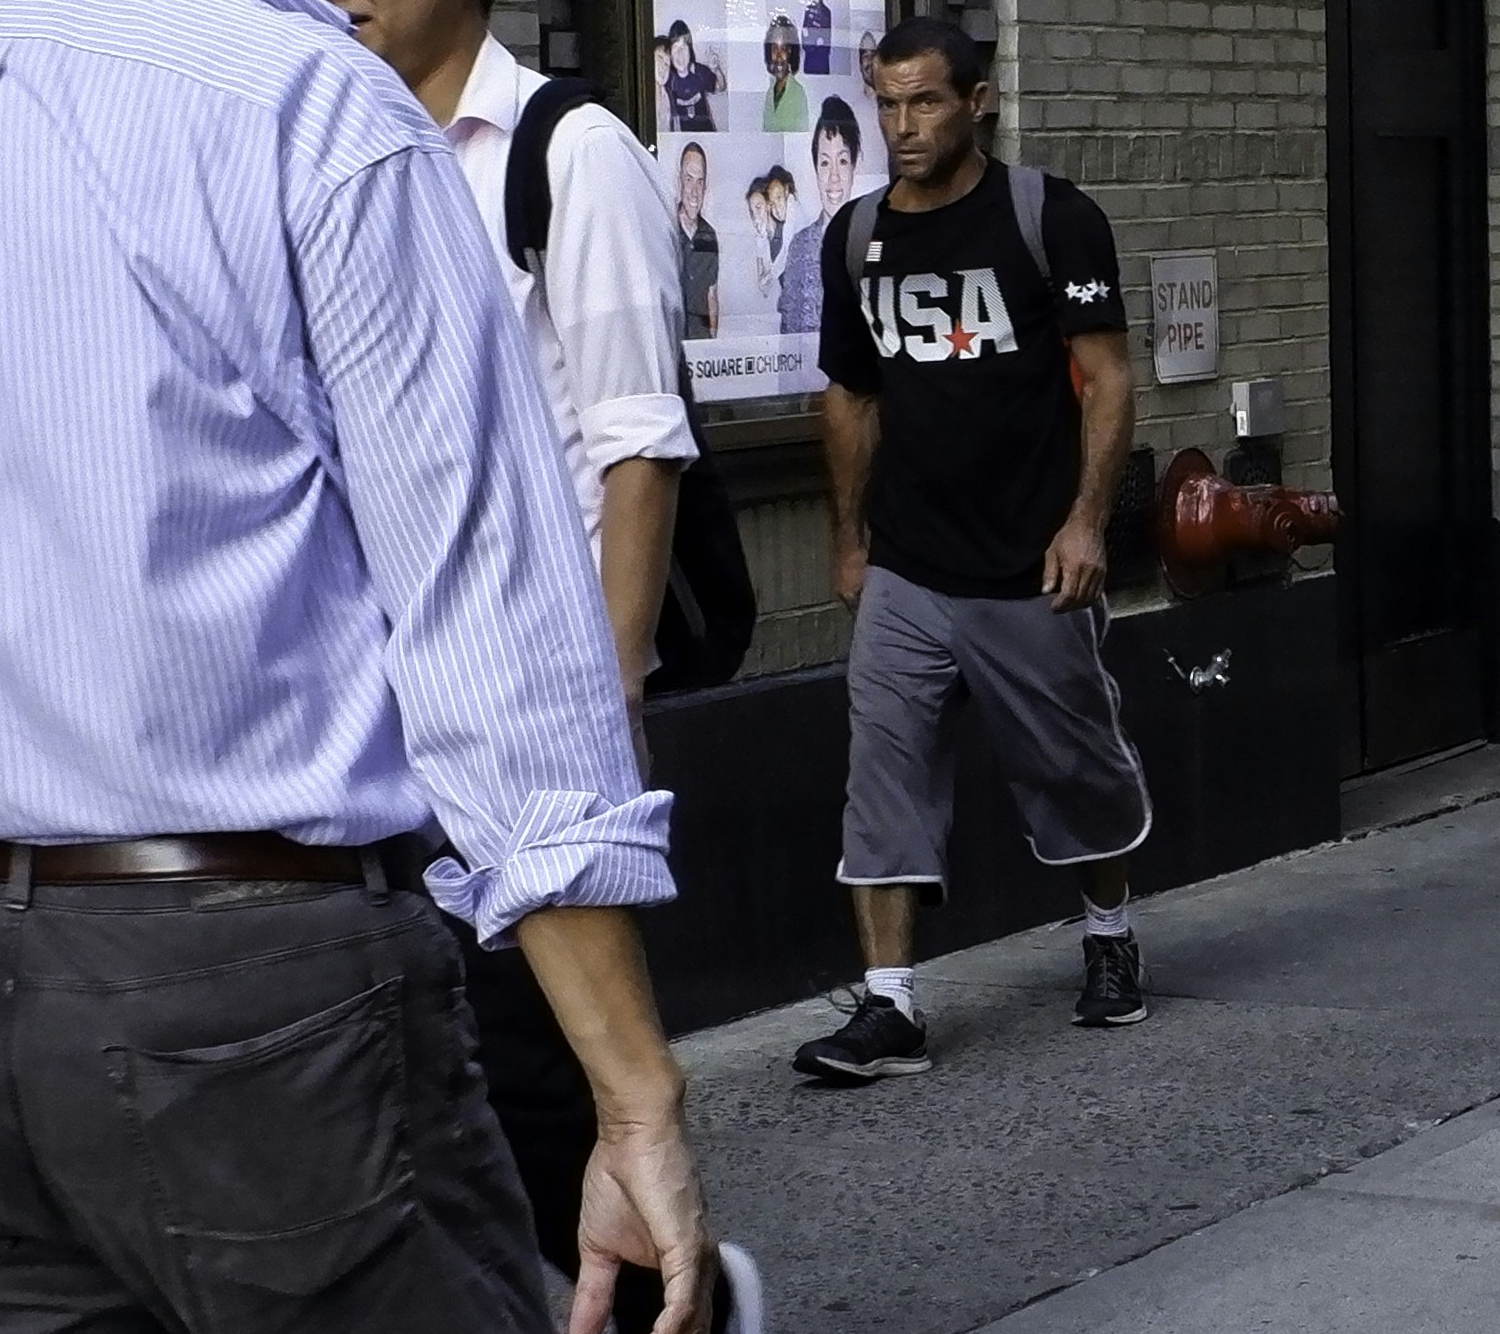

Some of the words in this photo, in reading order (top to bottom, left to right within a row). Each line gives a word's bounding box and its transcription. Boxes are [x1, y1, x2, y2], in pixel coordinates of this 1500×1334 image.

[1157, 279, 1213, 313] STAND
[860, 267, 1019, 363] USA
[1167, 321, 1205, 352] PIPE
[696, 357, 744, 379] SQUARE
[756, 353, 802, 374] CHURCH
